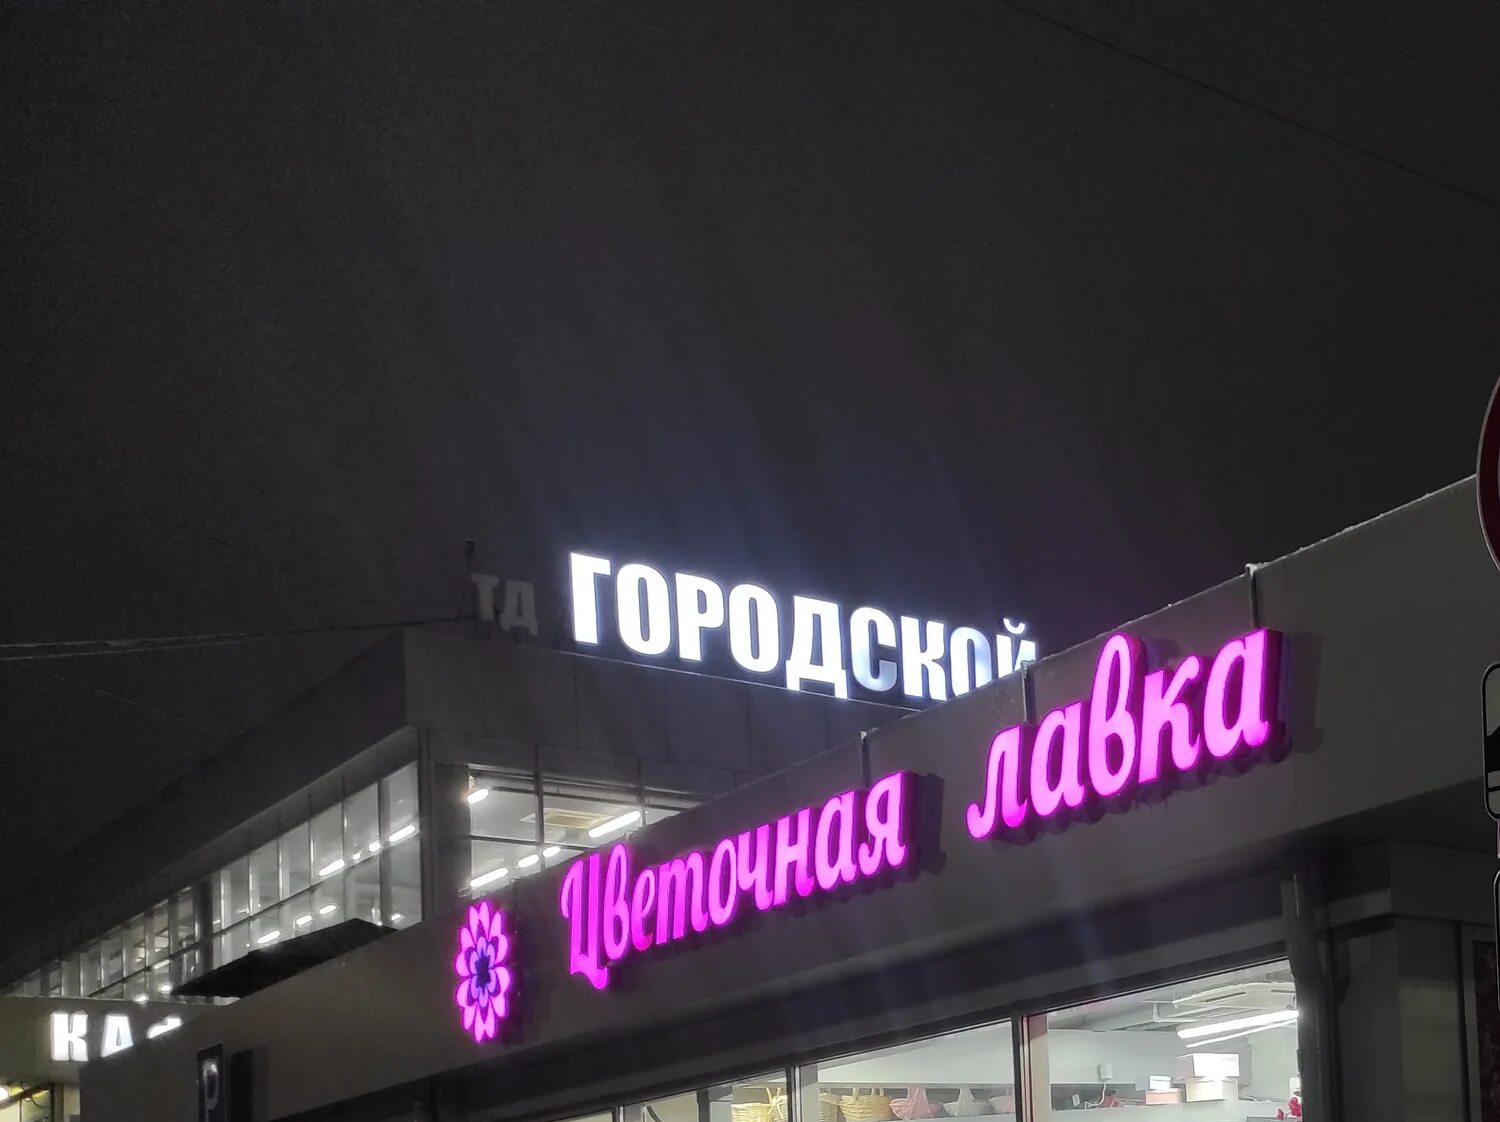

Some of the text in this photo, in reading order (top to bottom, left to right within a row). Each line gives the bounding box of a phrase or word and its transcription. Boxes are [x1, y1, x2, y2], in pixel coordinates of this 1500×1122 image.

[470, 552, 1037, 701] ТД ГОРОДСКОЙ
[560, 627, 1270, 991] Цветочная лавка
[50, 1011, 183, 1062] КА
